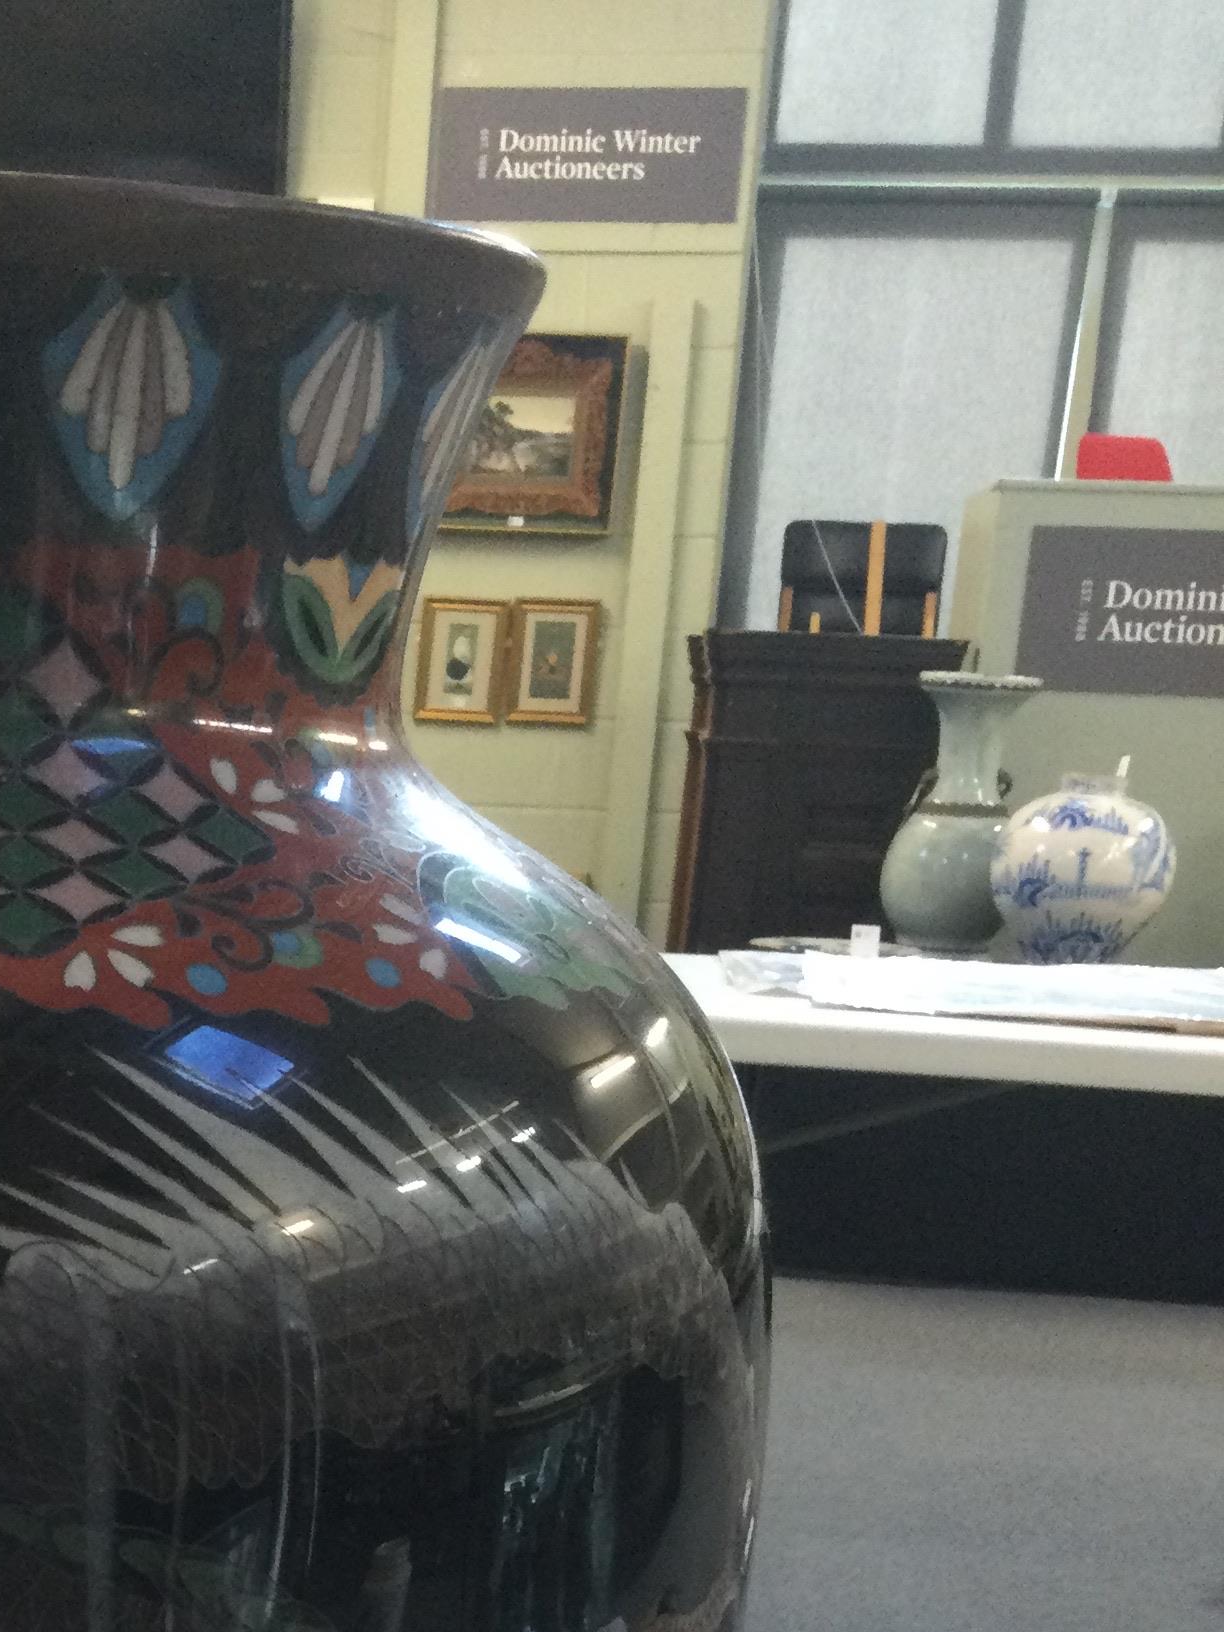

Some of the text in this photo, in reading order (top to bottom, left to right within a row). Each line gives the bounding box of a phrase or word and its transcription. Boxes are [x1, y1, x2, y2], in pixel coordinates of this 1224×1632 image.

[498, 127, 702, 154] Dominic Winter
[494, 154, 646, 180] Auctioneers
